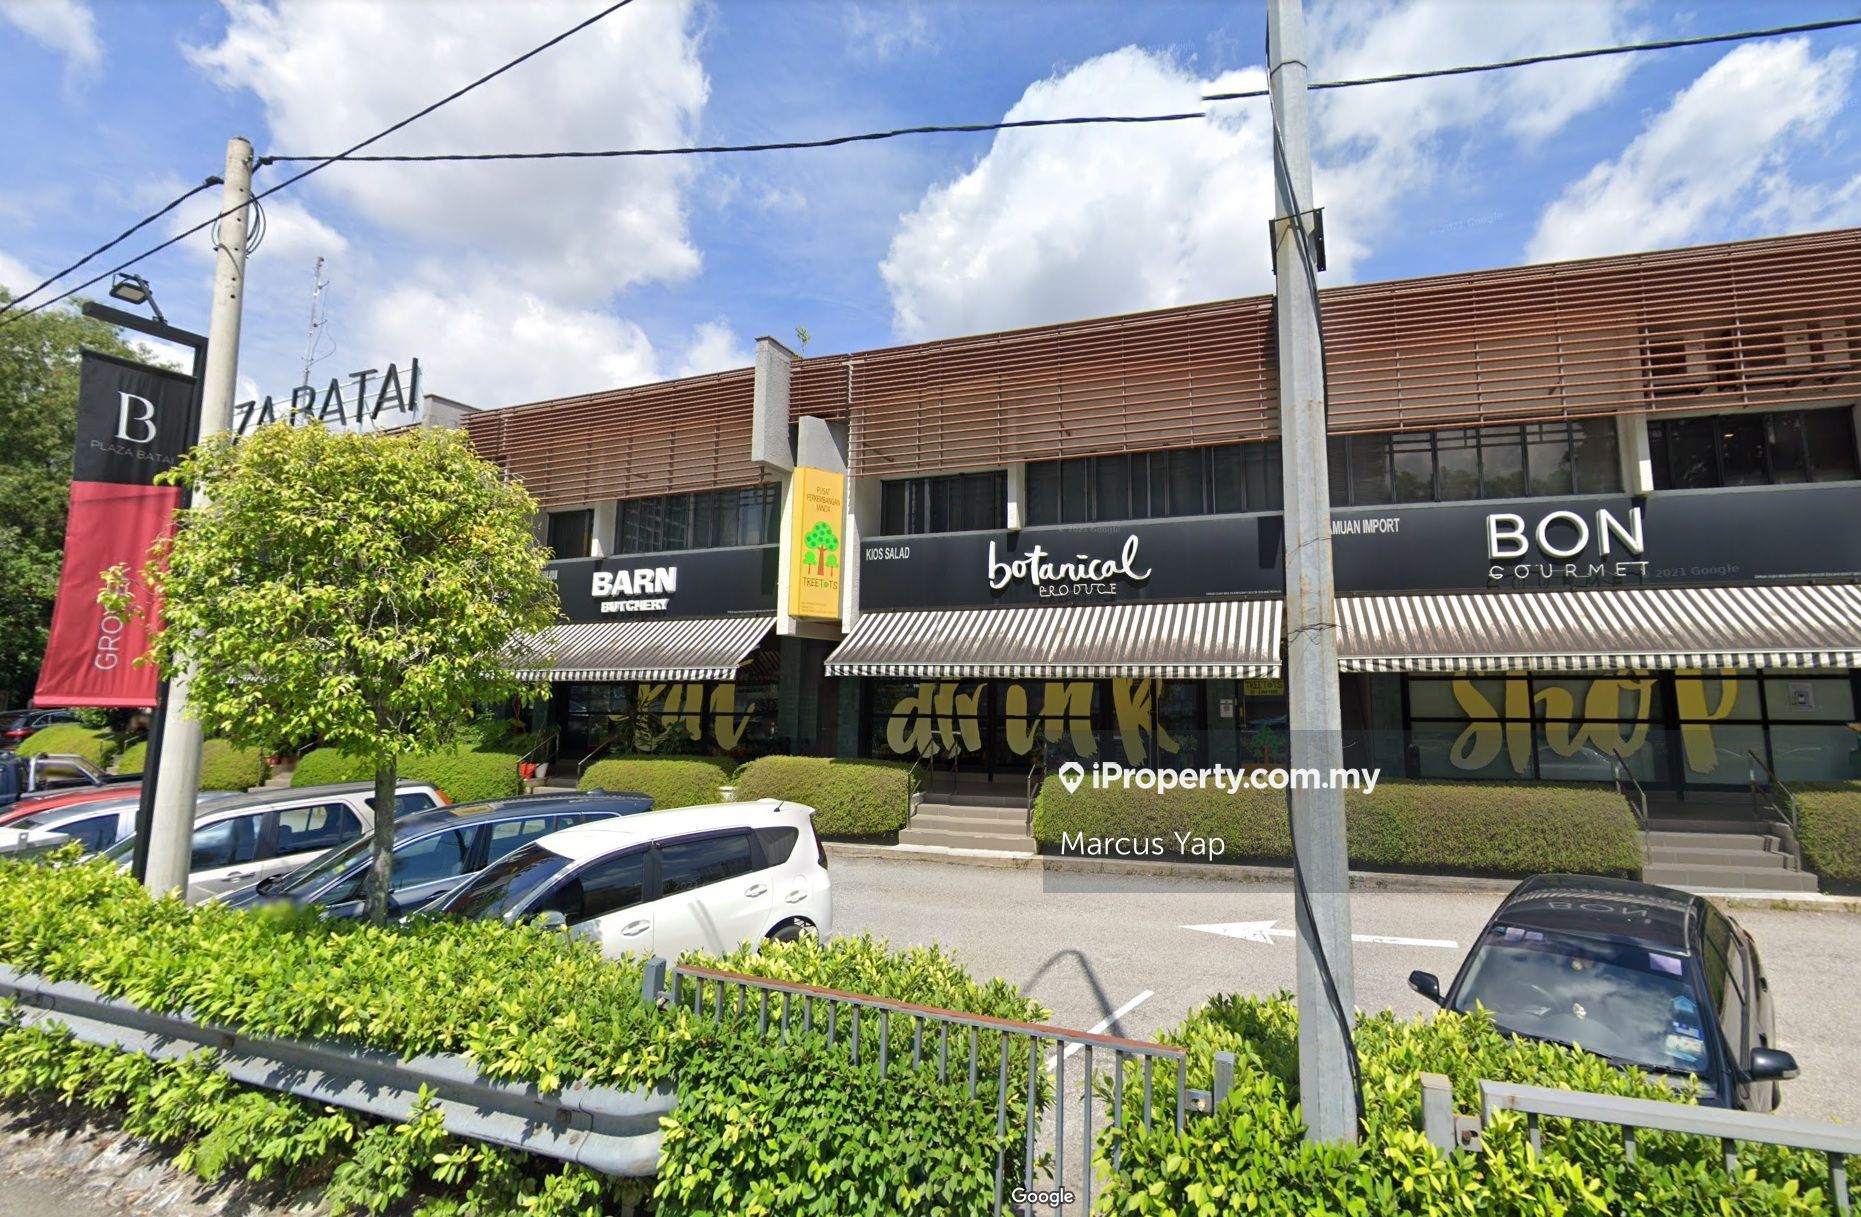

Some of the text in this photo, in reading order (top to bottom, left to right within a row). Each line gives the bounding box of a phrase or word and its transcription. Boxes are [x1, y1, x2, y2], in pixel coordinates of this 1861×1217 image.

[289, 357, 419, 427] BATAI
[114, 390, 157, 444] B
[90, 440, 175, 465] PLAZA BATAI
[1330, 518, 1400, 535] MUAN IMPORT
[1486, 506, 1645, 560] BON
[865, 546, 911, 560] KIOS SALAD
[988, 533, 1153, 590] botanical
[591, 566, 678, 598] BARN
[1488, 561, 1650, 580] GOURMET
[1039, 583, 1118, 597] PRODUCE
[601, 598, 670, 613] BUTCHERY
